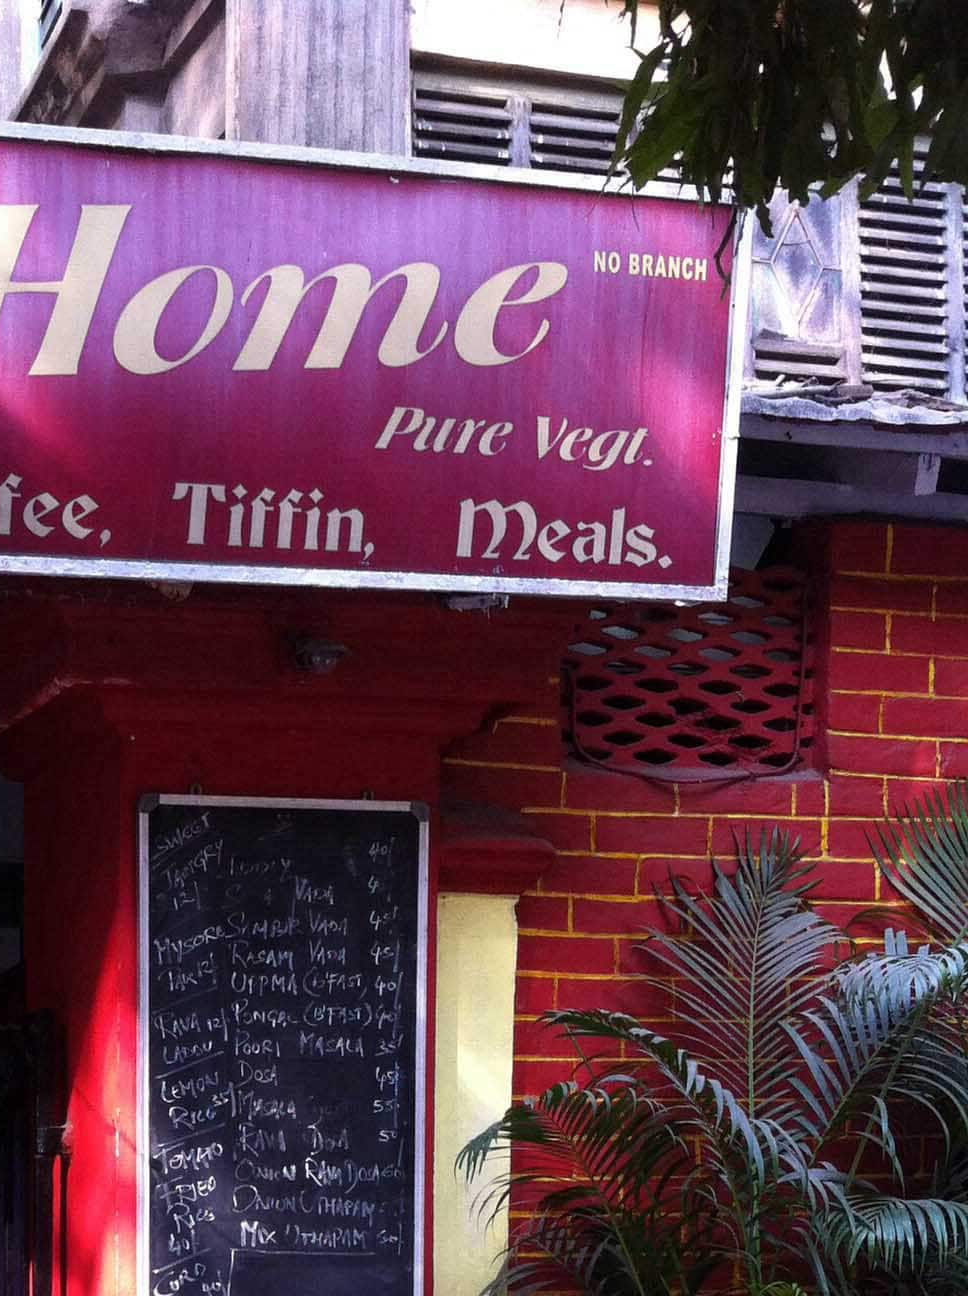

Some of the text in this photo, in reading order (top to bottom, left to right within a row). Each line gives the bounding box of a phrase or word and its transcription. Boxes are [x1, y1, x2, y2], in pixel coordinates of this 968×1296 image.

[593, 250, 708, 281] NO BRANCH
[375, 406, 654, 471] Pure Vegt.
[172, 482, 375, 560] Tiffin,
[456, 498, 673, 569] Meals.
